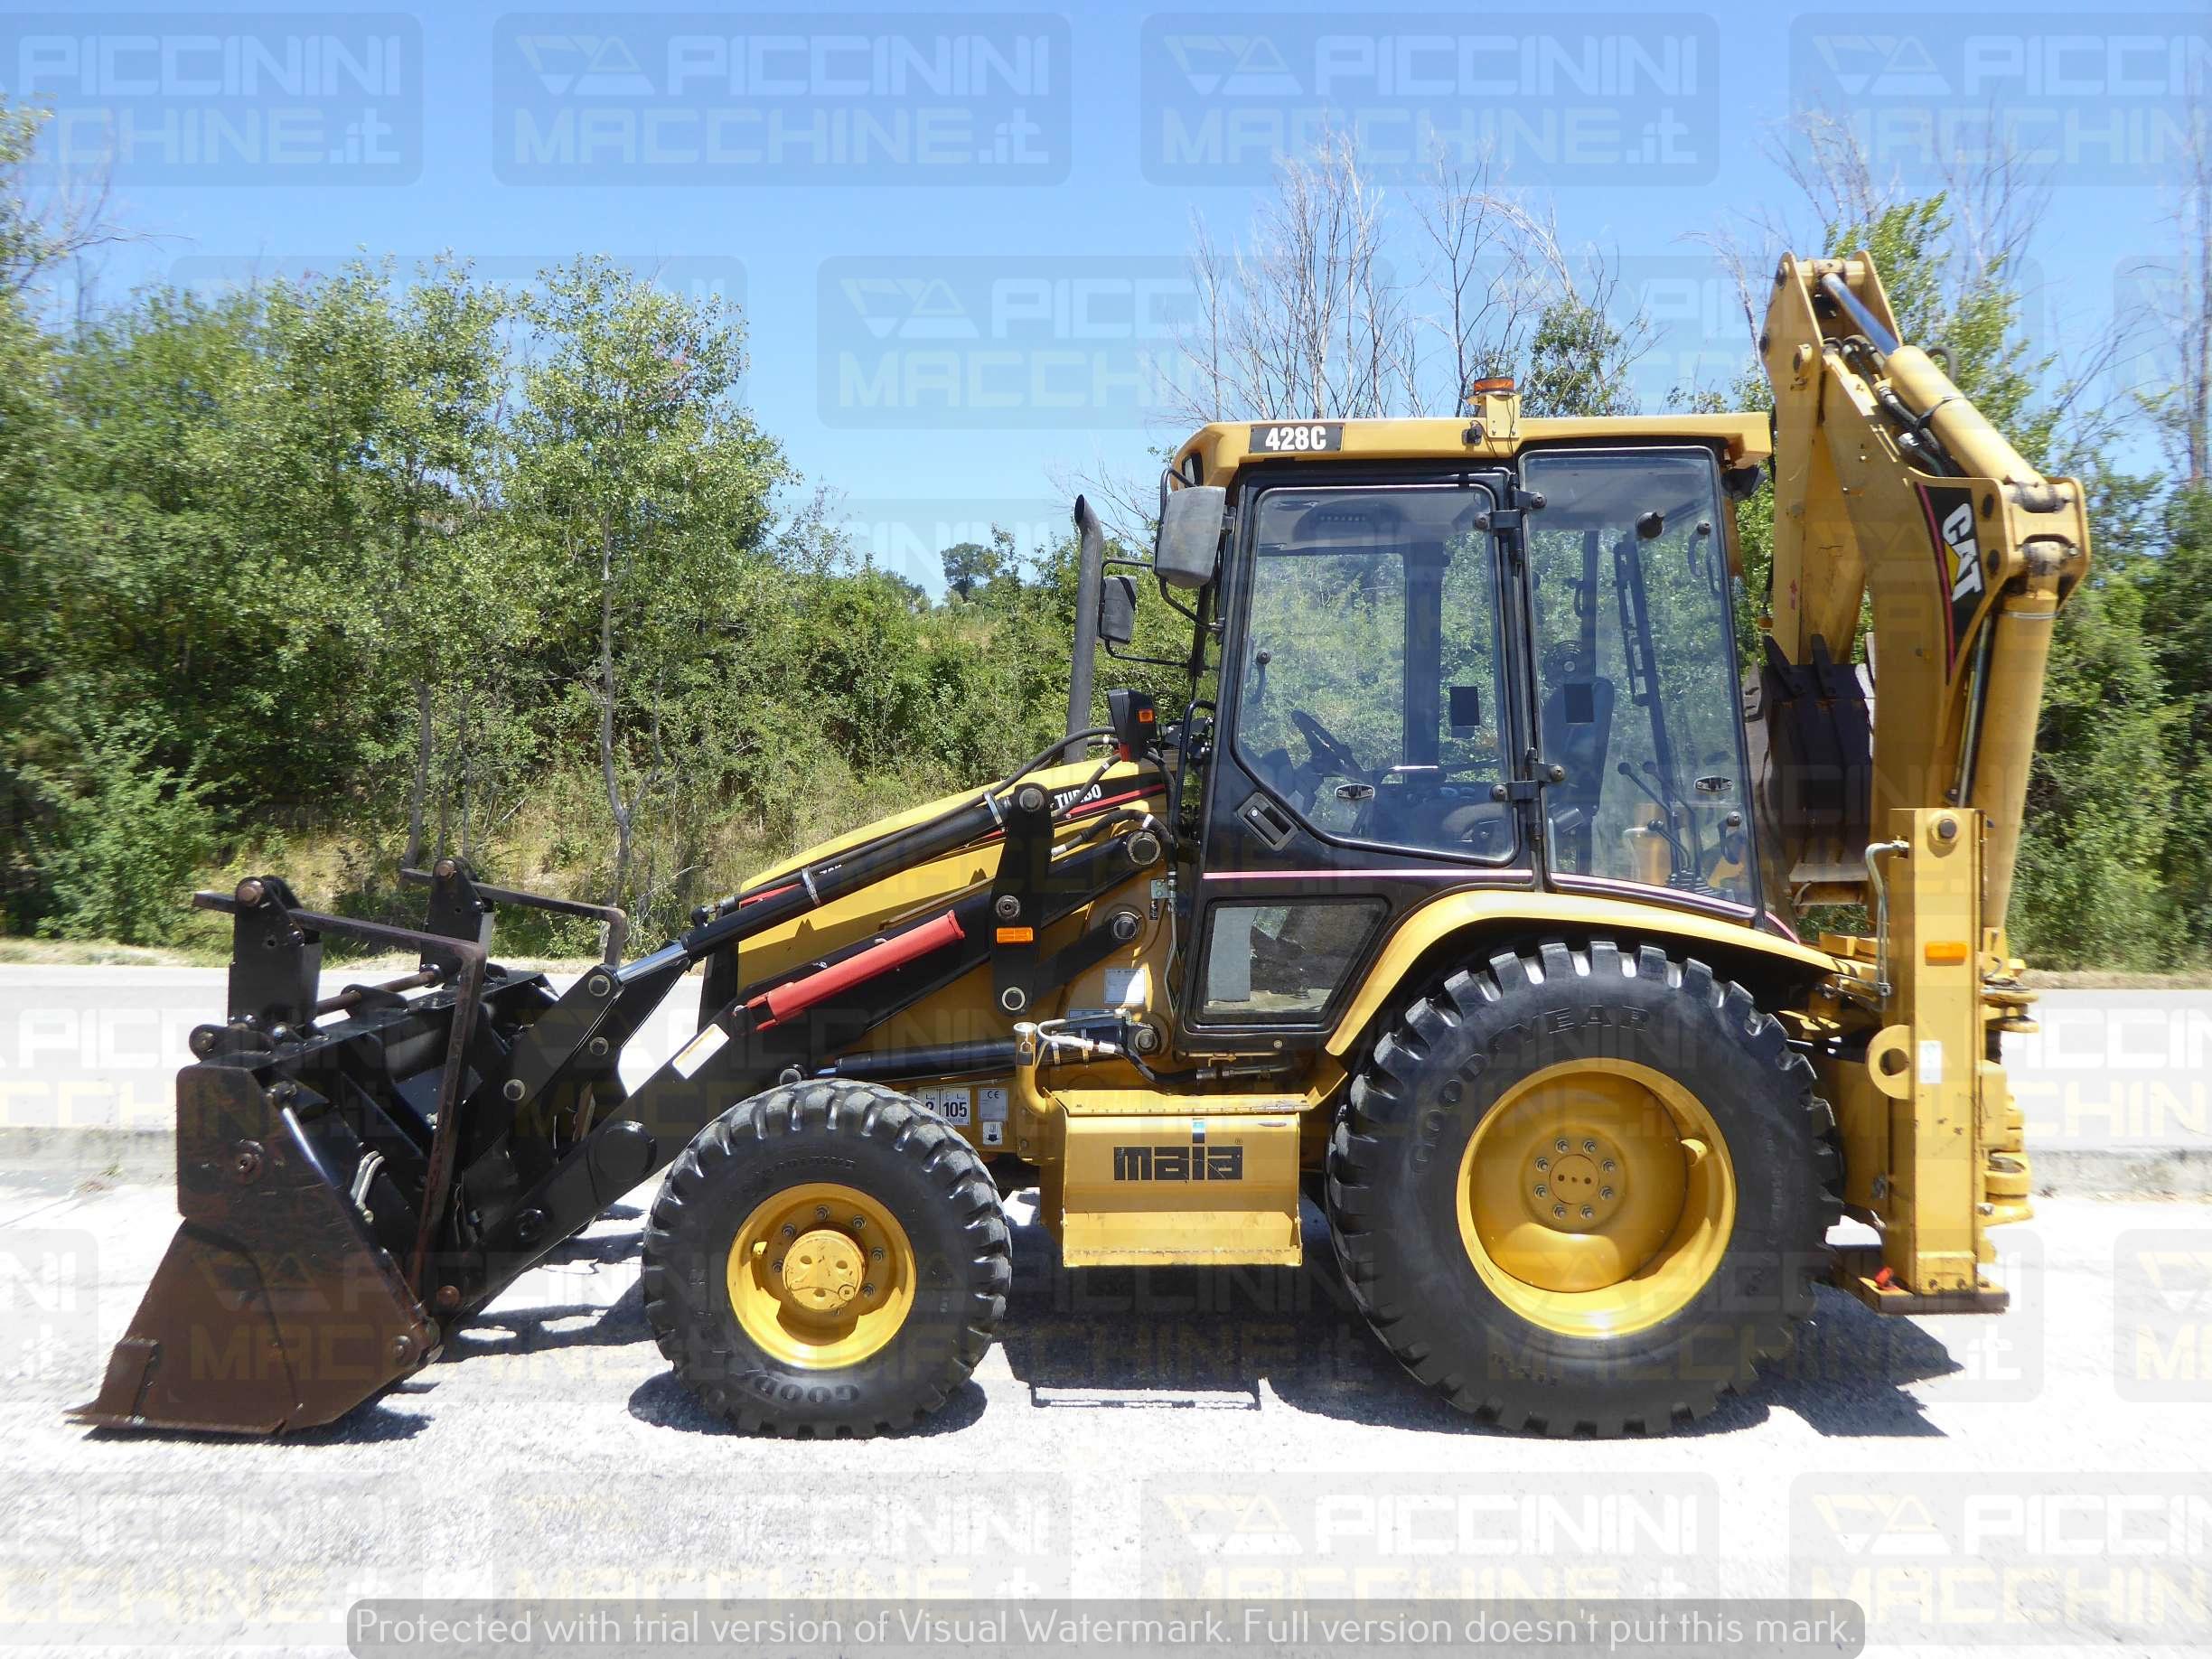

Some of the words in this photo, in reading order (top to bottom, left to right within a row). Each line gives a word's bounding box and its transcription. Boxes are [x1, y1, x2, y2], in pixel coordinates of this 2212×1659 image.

[1265, 425, 1326, 451] 428C
[1942, 502, 1982, 603] CAT
[1054, 783, 1102, 811] TUBO
[943, 1101, 967, 1117] 105
